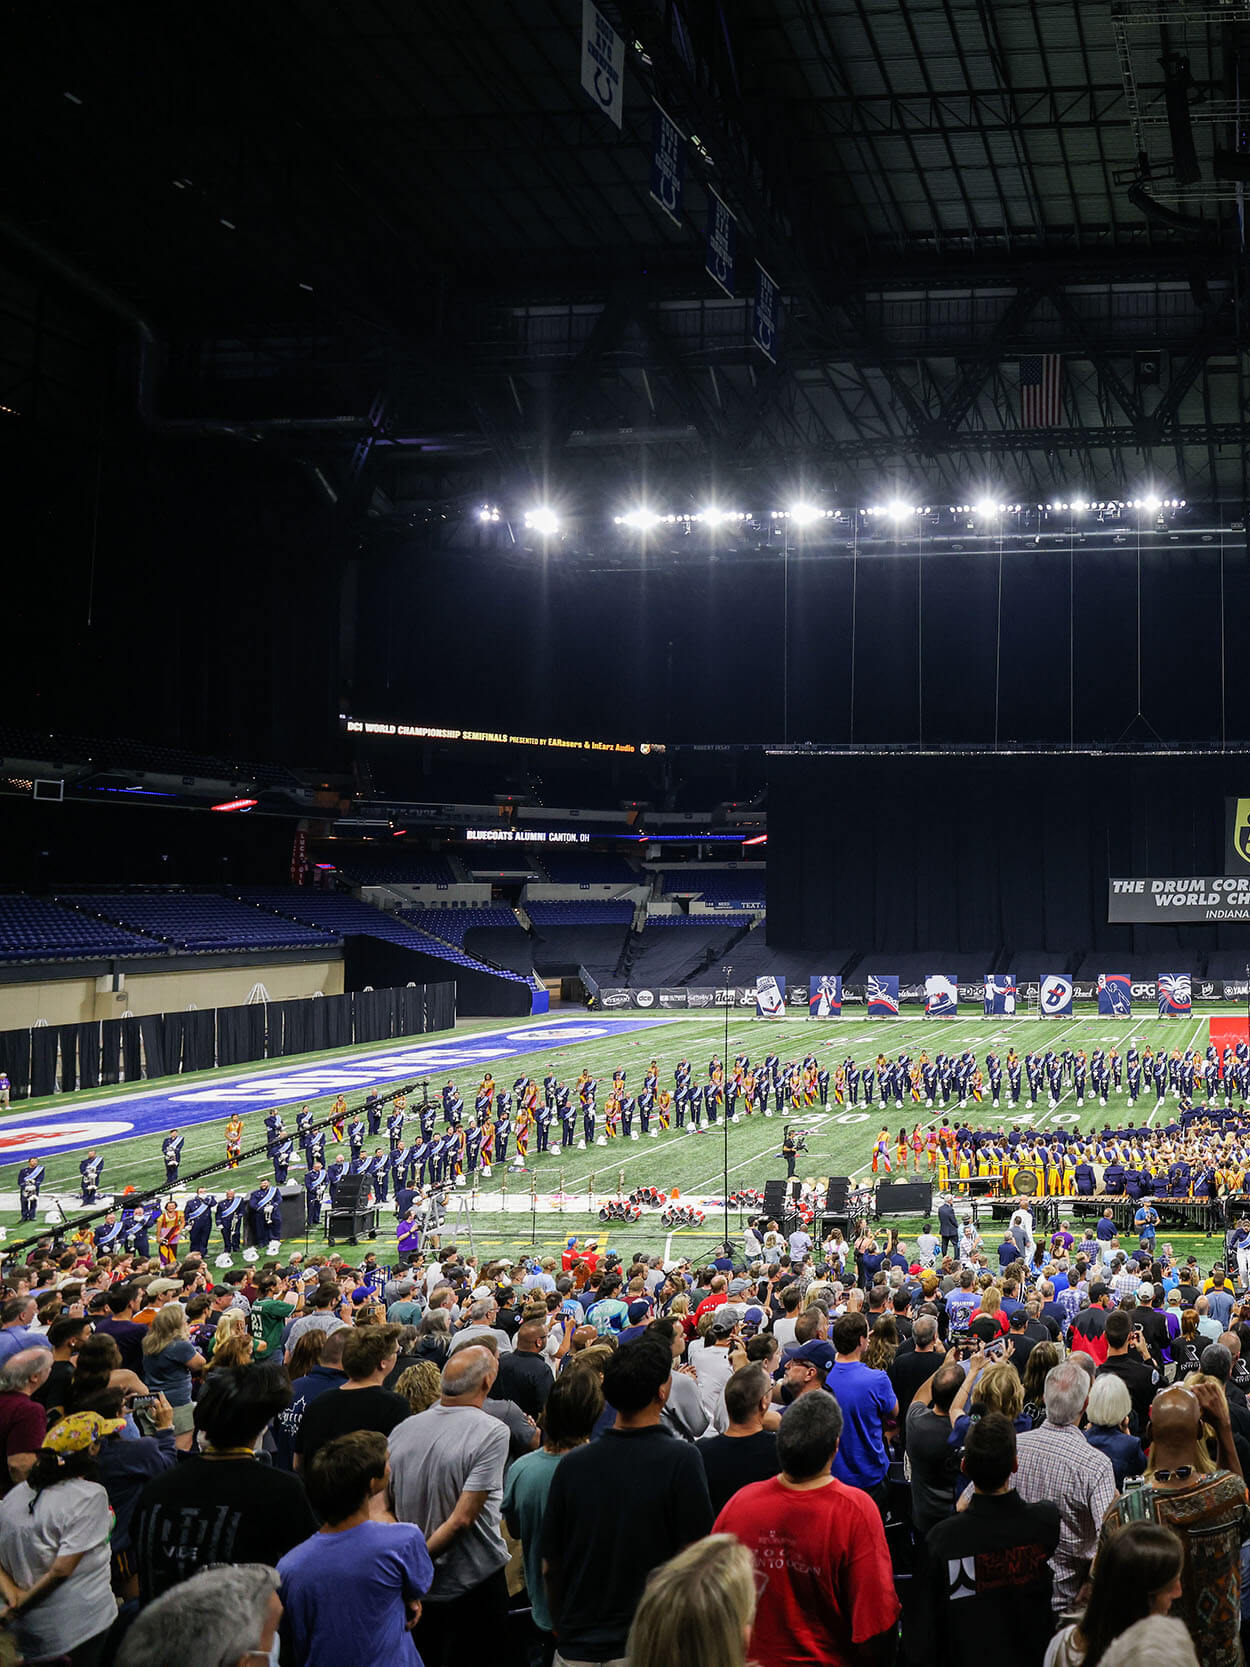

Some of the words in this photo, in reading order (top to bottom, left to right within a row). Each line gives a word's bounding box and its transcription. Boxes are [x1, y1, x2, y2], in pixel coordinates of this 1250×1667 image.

[348, 722, 363, 732] DCI
[365, 723, 396, 734] WORLD
[398, 726, 462, 739] CHAMPIONSHIP
[462, 730, 508, 742] SEMIFINALS
[509, 736, 538, 746] PRESENTED
[548, 738, 582, 749] EARasers
[584, 740, 590, 750] &
[615, 743, 635, 753] Audio
[466, 830, 514, 841] BLUECOATS
[515, 830, 546, 842] ALUMNI
[548, 832, 578, 843] CANTON,
[580, 832, 590, 842] OH
[1112, 881, 1144, 893] THE
[1150, 880, 1206, 892] DRUM
[1154, 893, 1220, 906] WORLD
